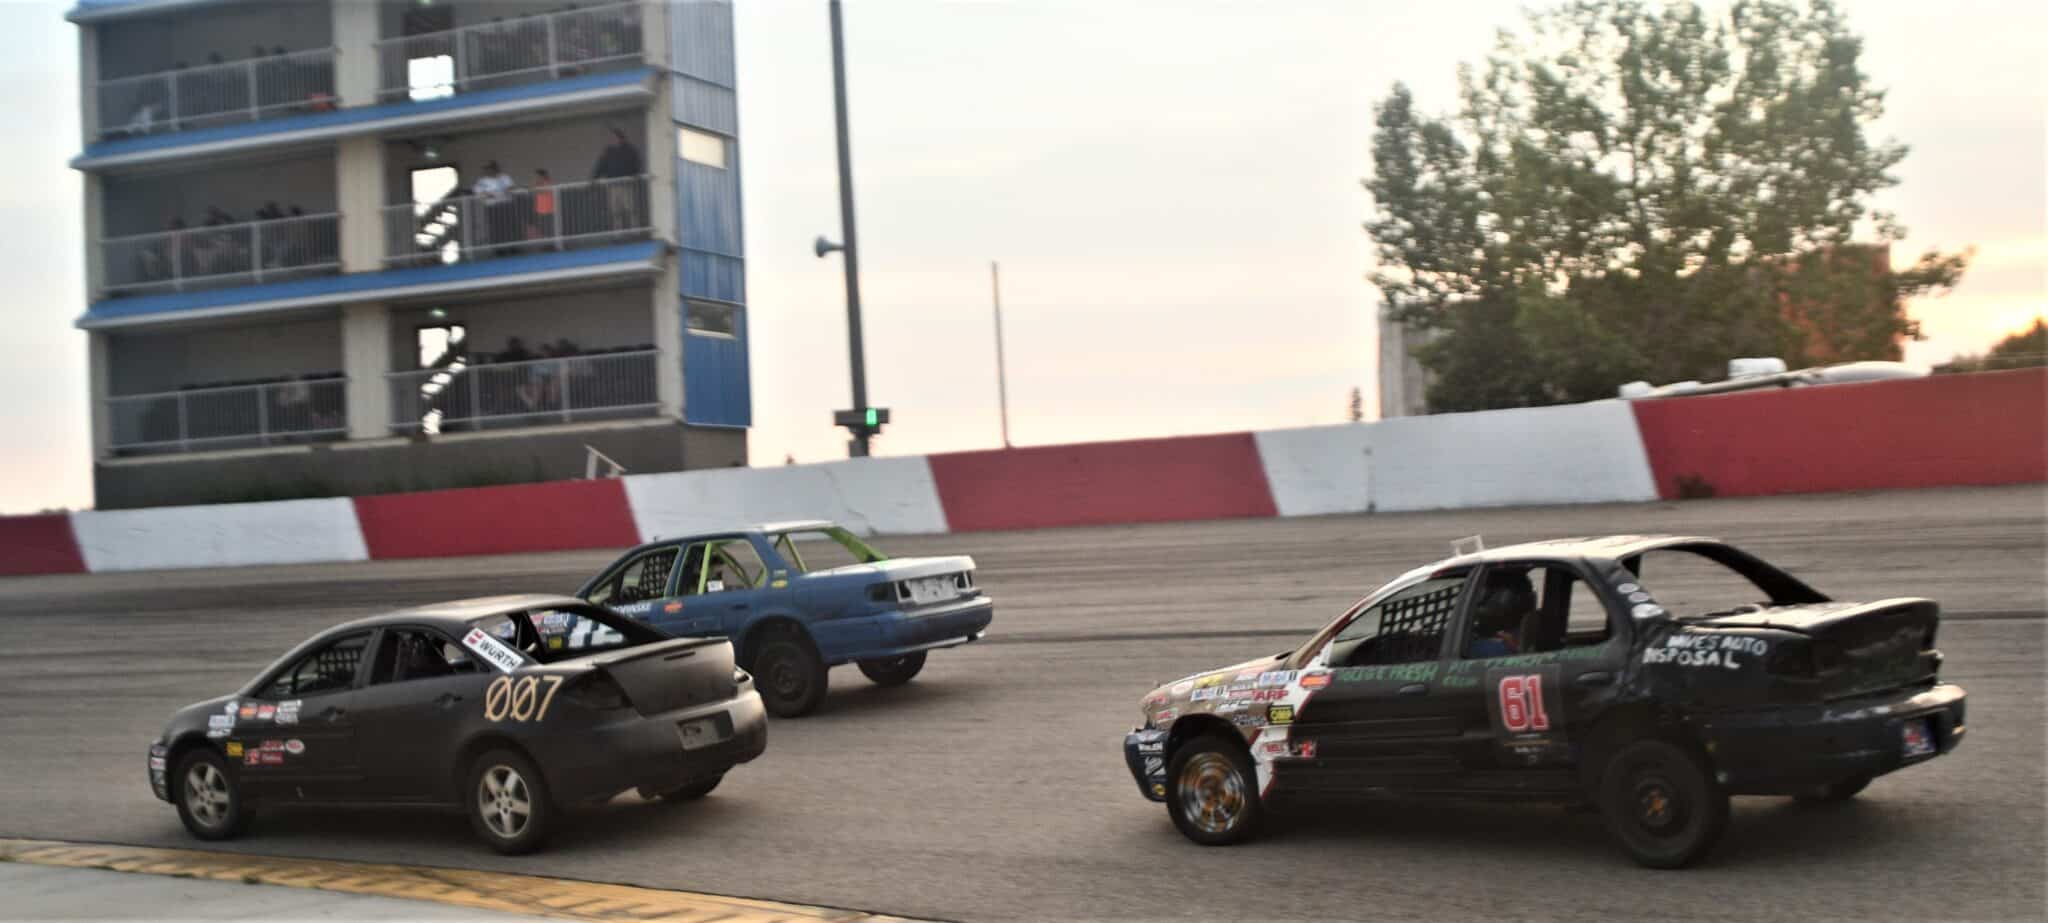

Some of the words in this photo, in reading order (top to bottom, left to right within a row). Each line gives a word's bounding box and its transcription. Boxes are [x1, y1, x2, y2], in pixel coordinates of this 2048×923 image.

[1642, 647, 1741, 669] DISPOSAL
[1720, 635, 1768, 656] AUTO
[484, 674, 564, 722] 007
[1499, 674, 1550, 732] 61
